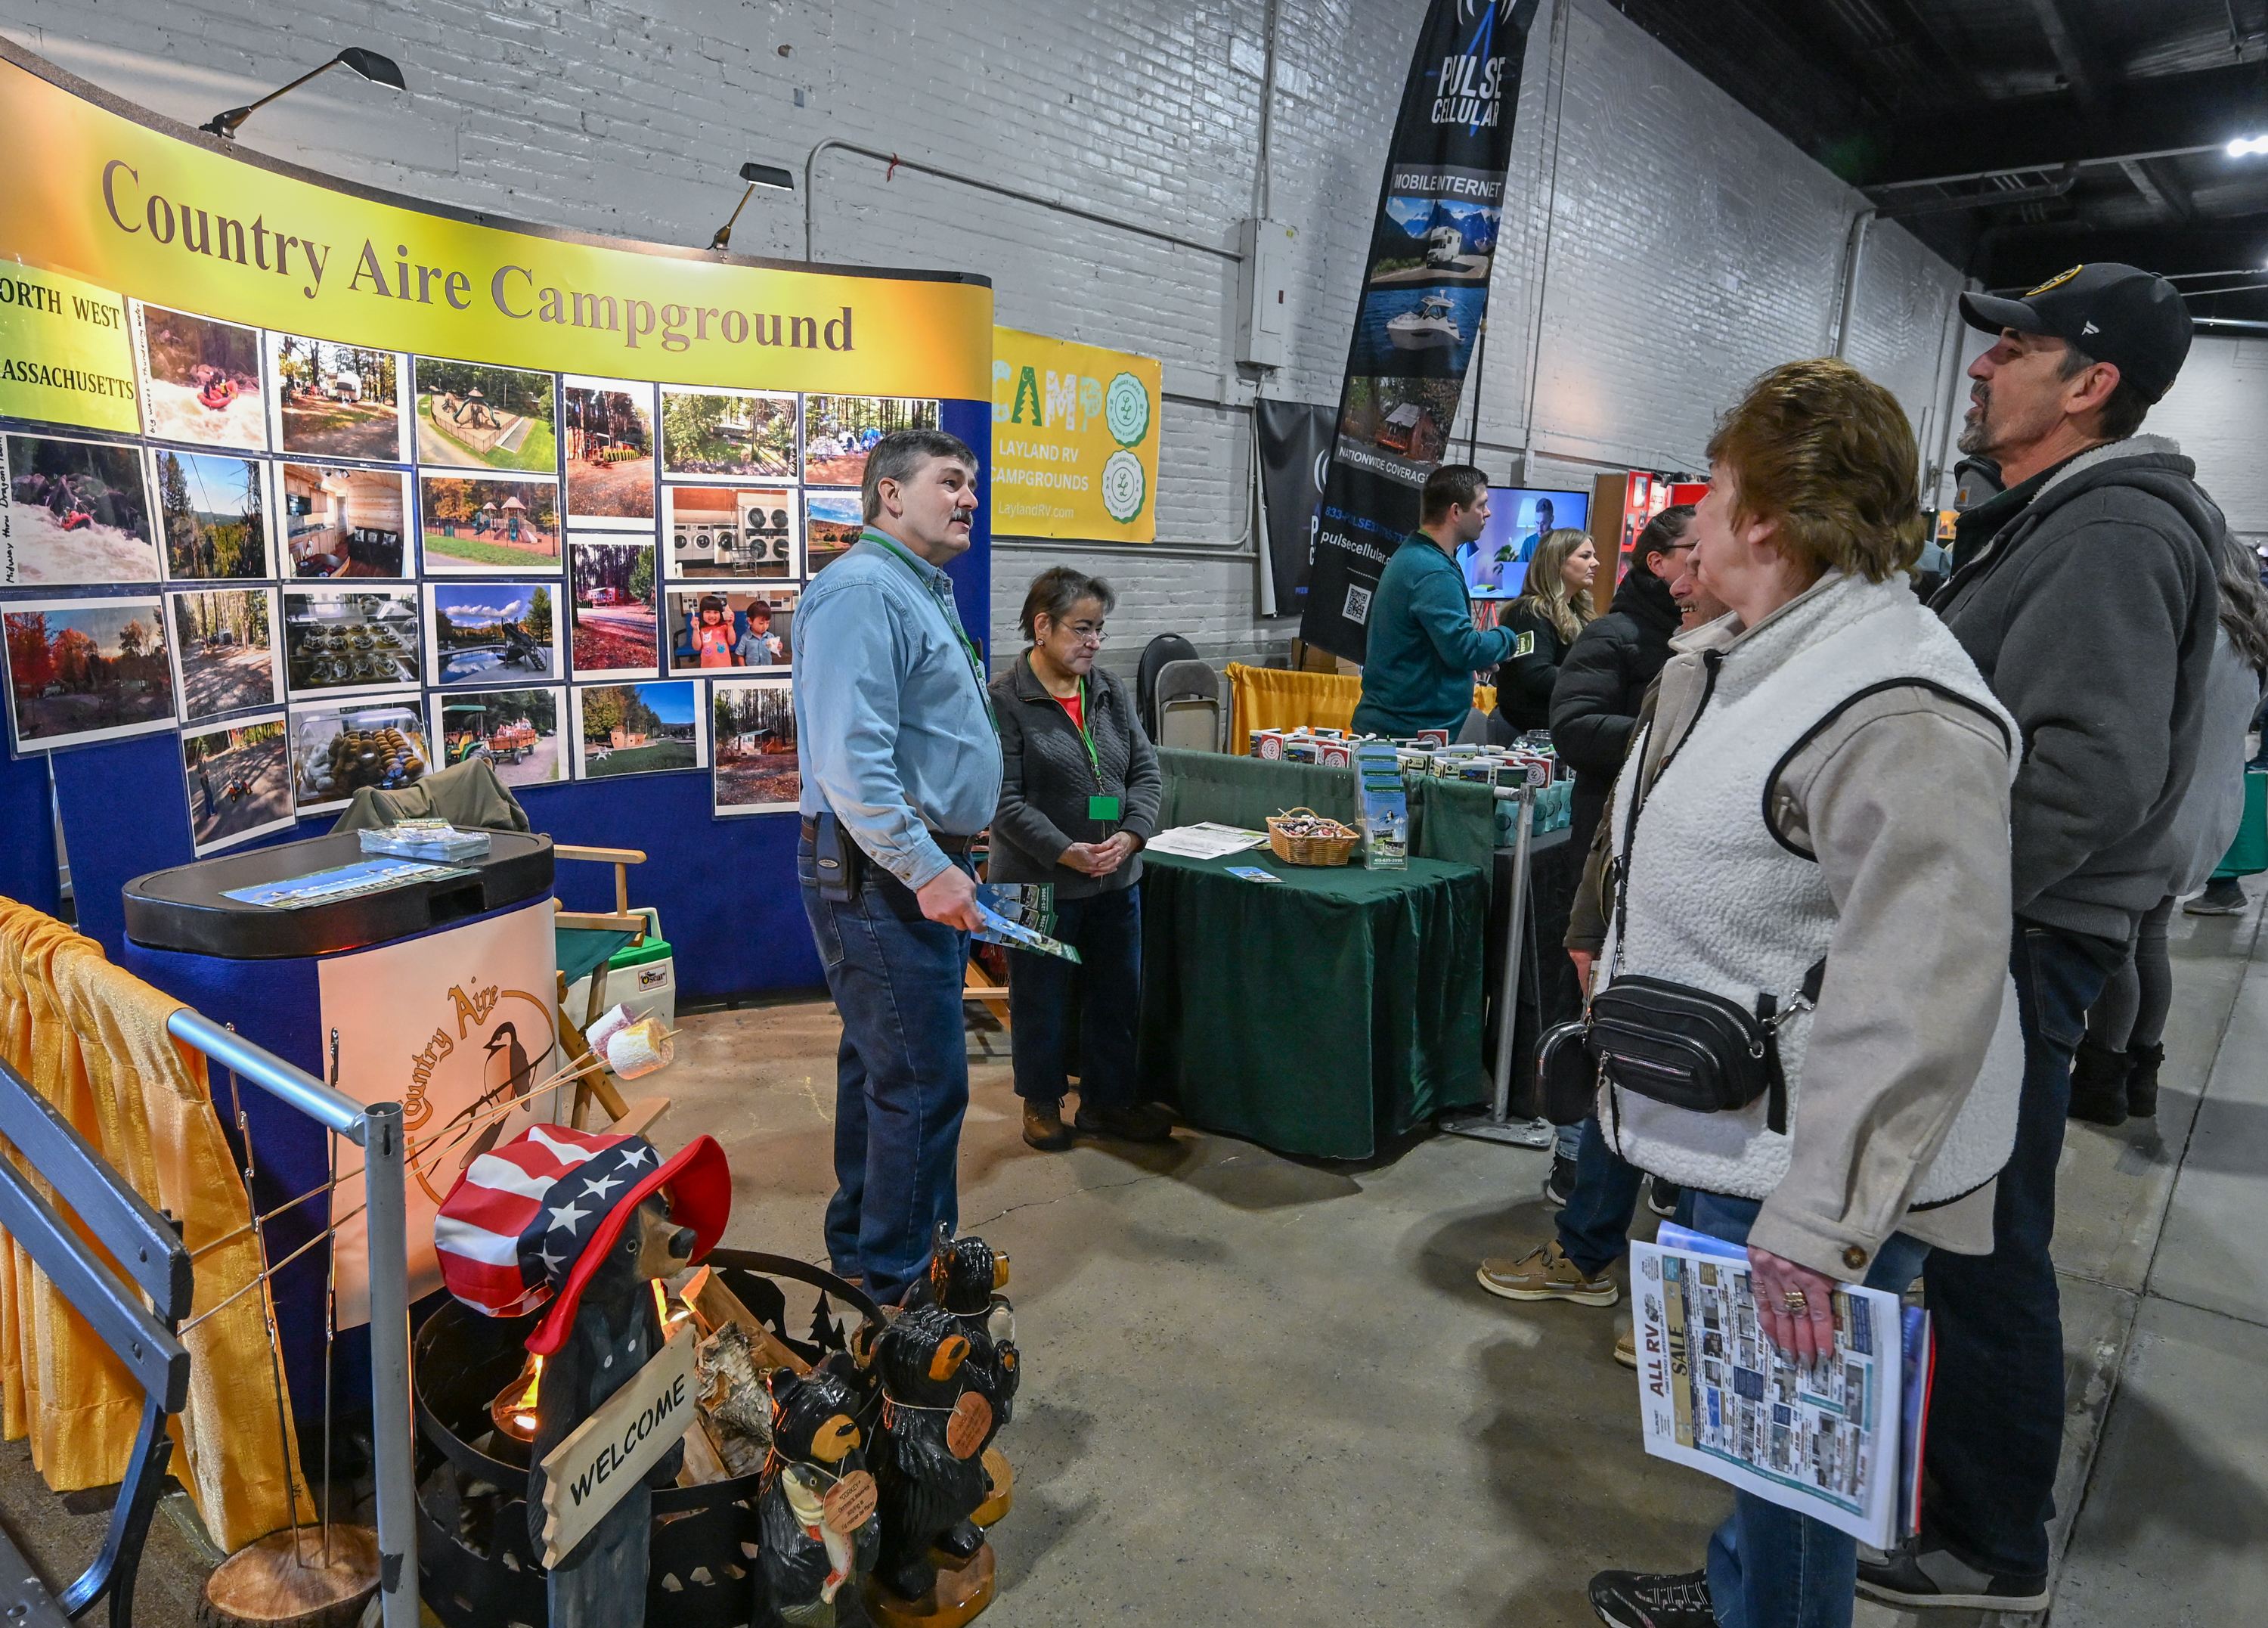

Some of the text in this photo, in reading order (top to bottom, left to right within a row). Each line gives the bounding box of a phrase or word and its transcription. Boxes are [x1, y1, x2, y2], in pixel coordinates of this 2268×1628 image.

[1437, 54, 1506, 99] PULSE
[1431, 97, 1500, 126] CELLULAR
[1394, 173, 1501, 198] MOBILE NTERNET
[102, 159, 855, 352] Country Aire Campground
[0, 278, 120, 330] ORTH WEST
[139, 330, 148, 376] thundering
[0, 358, 135, 400] ASSACHUSETTS
[992, 359, 1103, 433] CAMP
[999, 439, 1079, 463] LAYLAND RV
[1338, 446, 1385, 470] NATIONWIDE
[991, 466, 1089, 492] CAMPGROUNDS
[2, 515, 11, 538] thru
[998, 501, 1074, 519] LaylandRV.com
[6, 543, 14, 583] Midway
[1320, 531, 1391, 565] pulsecellular.c
[448, 976, 499, 1040] Aire
[1644, 1323, 1665, 1397] ALL RV
[1668, 1324, 1688, 1377] SALE
[569, 1372, 686, 1507] WELCOME
